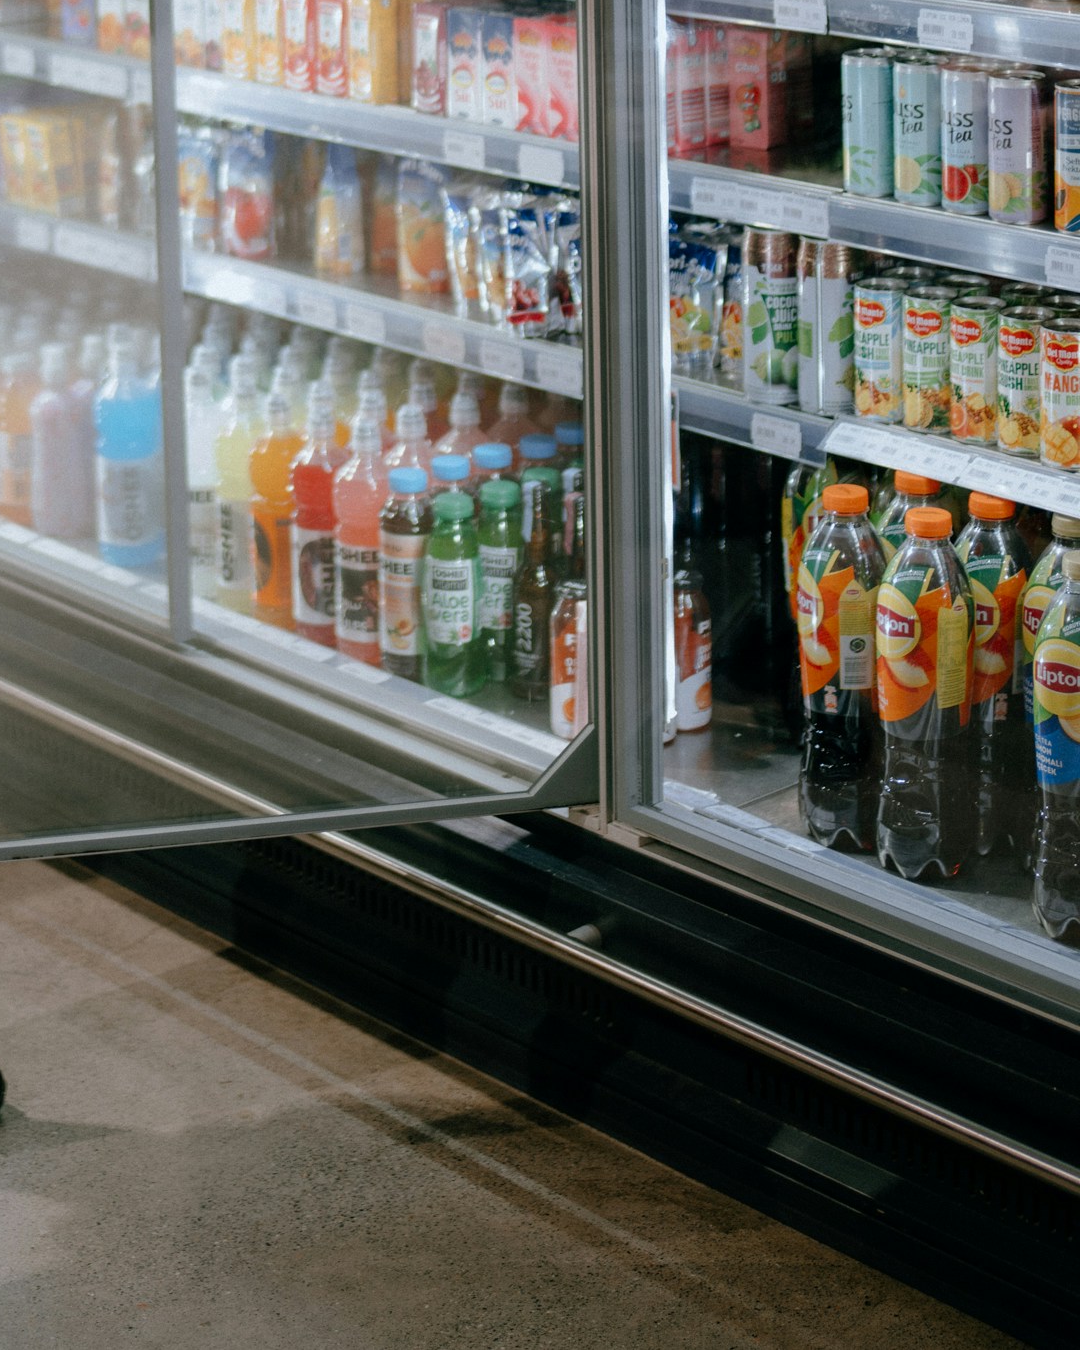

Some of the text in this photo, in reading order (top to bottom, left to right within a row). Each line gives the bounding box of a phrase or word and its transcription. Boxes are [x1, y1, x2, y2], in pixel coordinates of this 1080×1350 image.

[900, 119, 924, 135] tea
[949, 127, 974, 145] tea
[991, 134, 1013, 151] tea
[917, 317, 940, 327] Monte
[1008, 336, 1033, 347] Monte
[484, 595, 512, 610] era
[877, 607, 909, 634] ipton
[1024, 611, 1040, 632] Lip
[1037, 664, 1080, 688] Lipto
